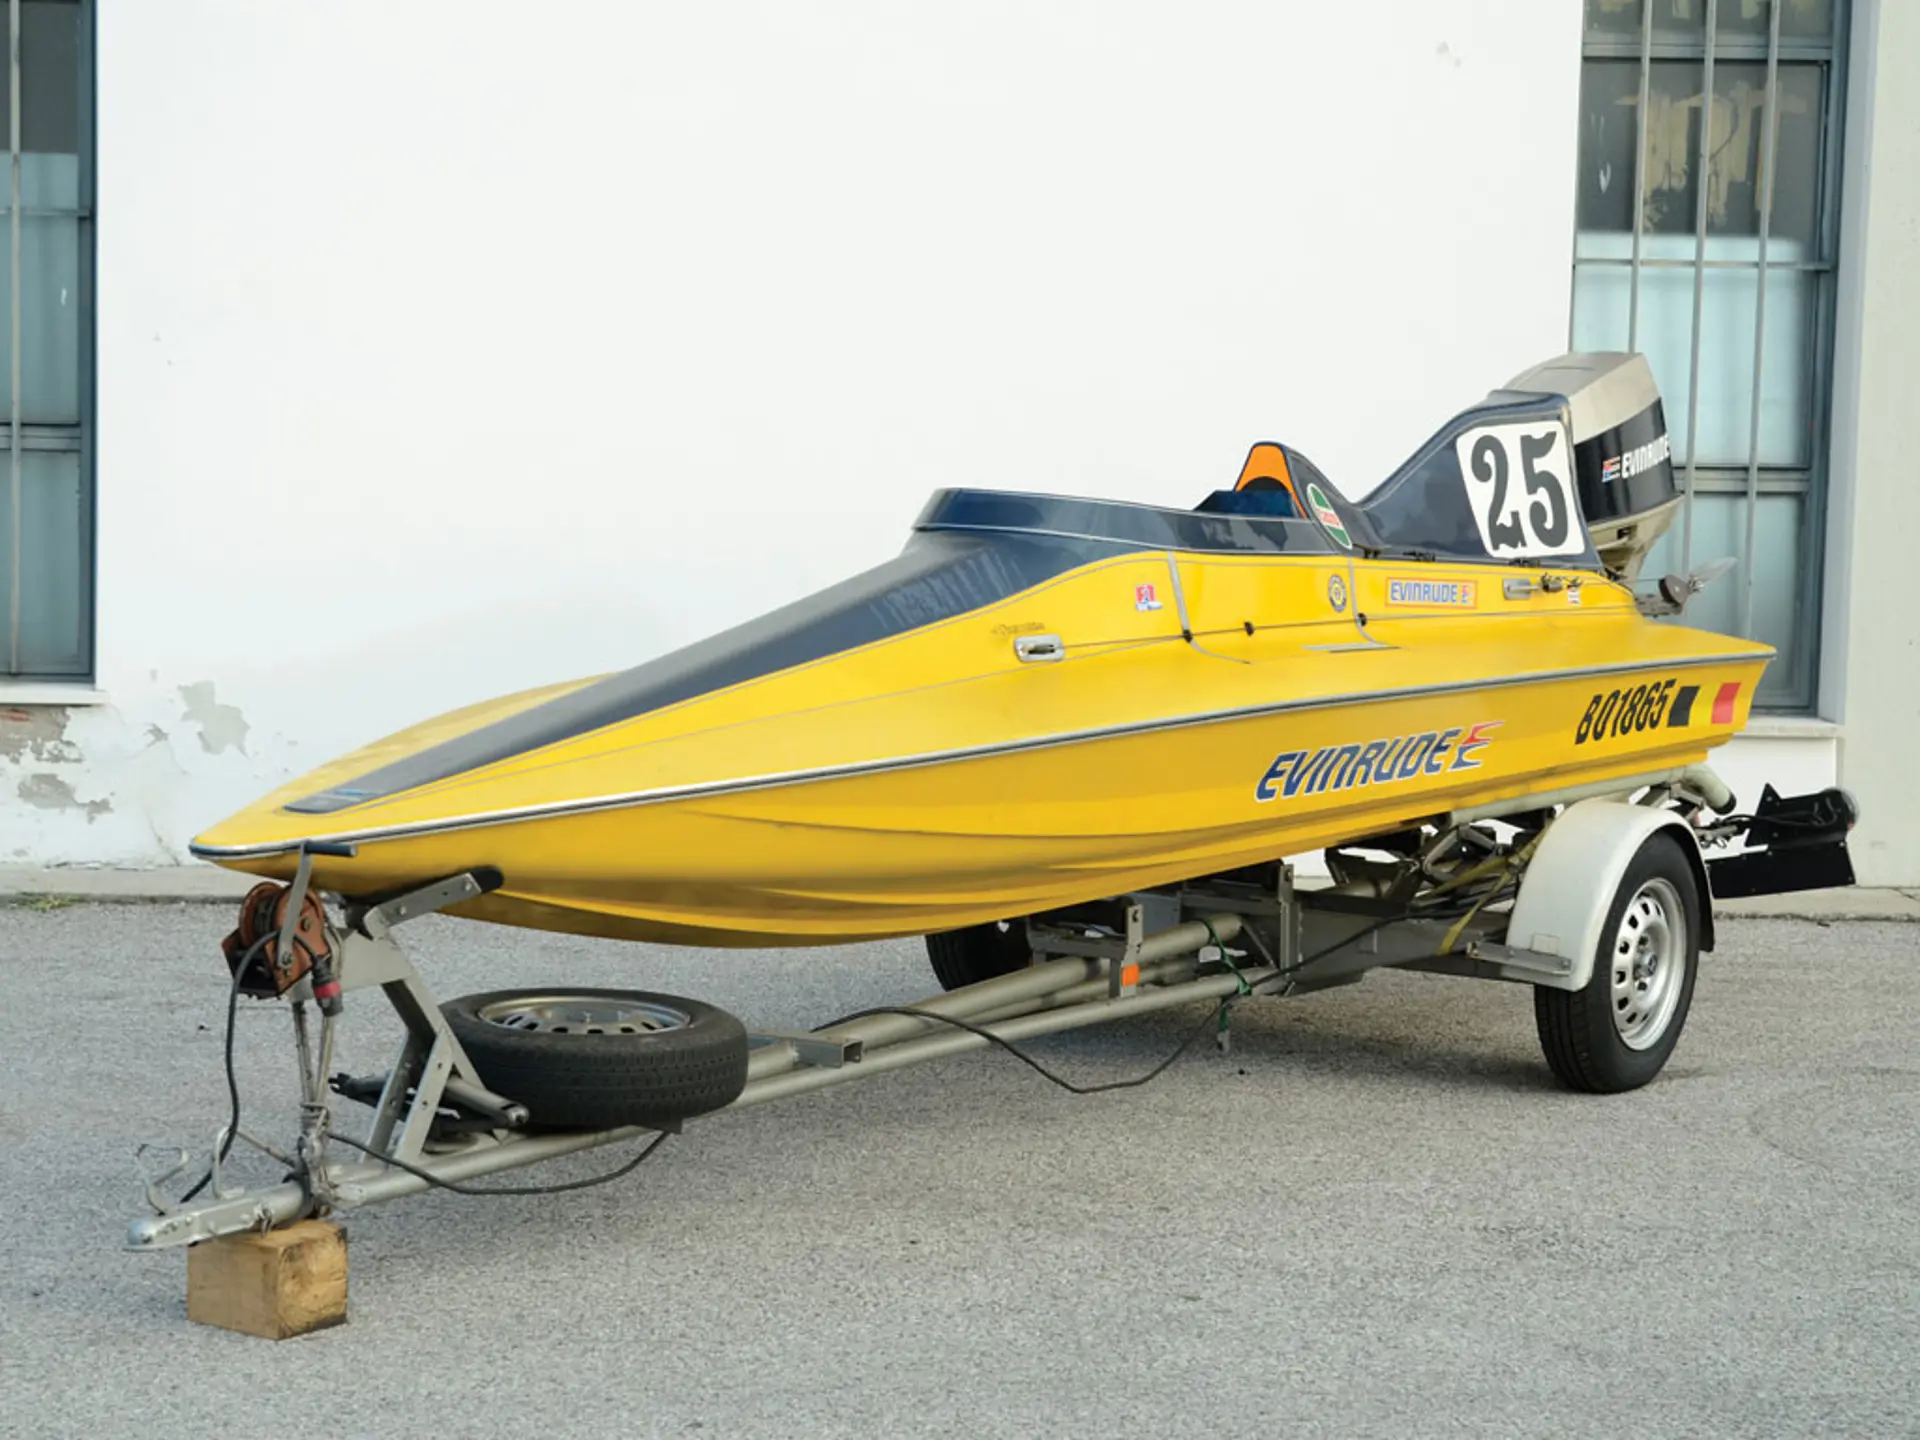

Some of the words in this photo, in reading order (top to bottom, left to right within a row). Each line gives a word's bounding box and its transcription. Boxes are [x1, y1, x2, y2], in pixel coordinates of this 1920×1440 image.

[1471, 431, 1569, 551] 25
[1389, 580, 1458, 604] EVINRUDE
[1255, 726, 1465, 803] EVINRUDE
